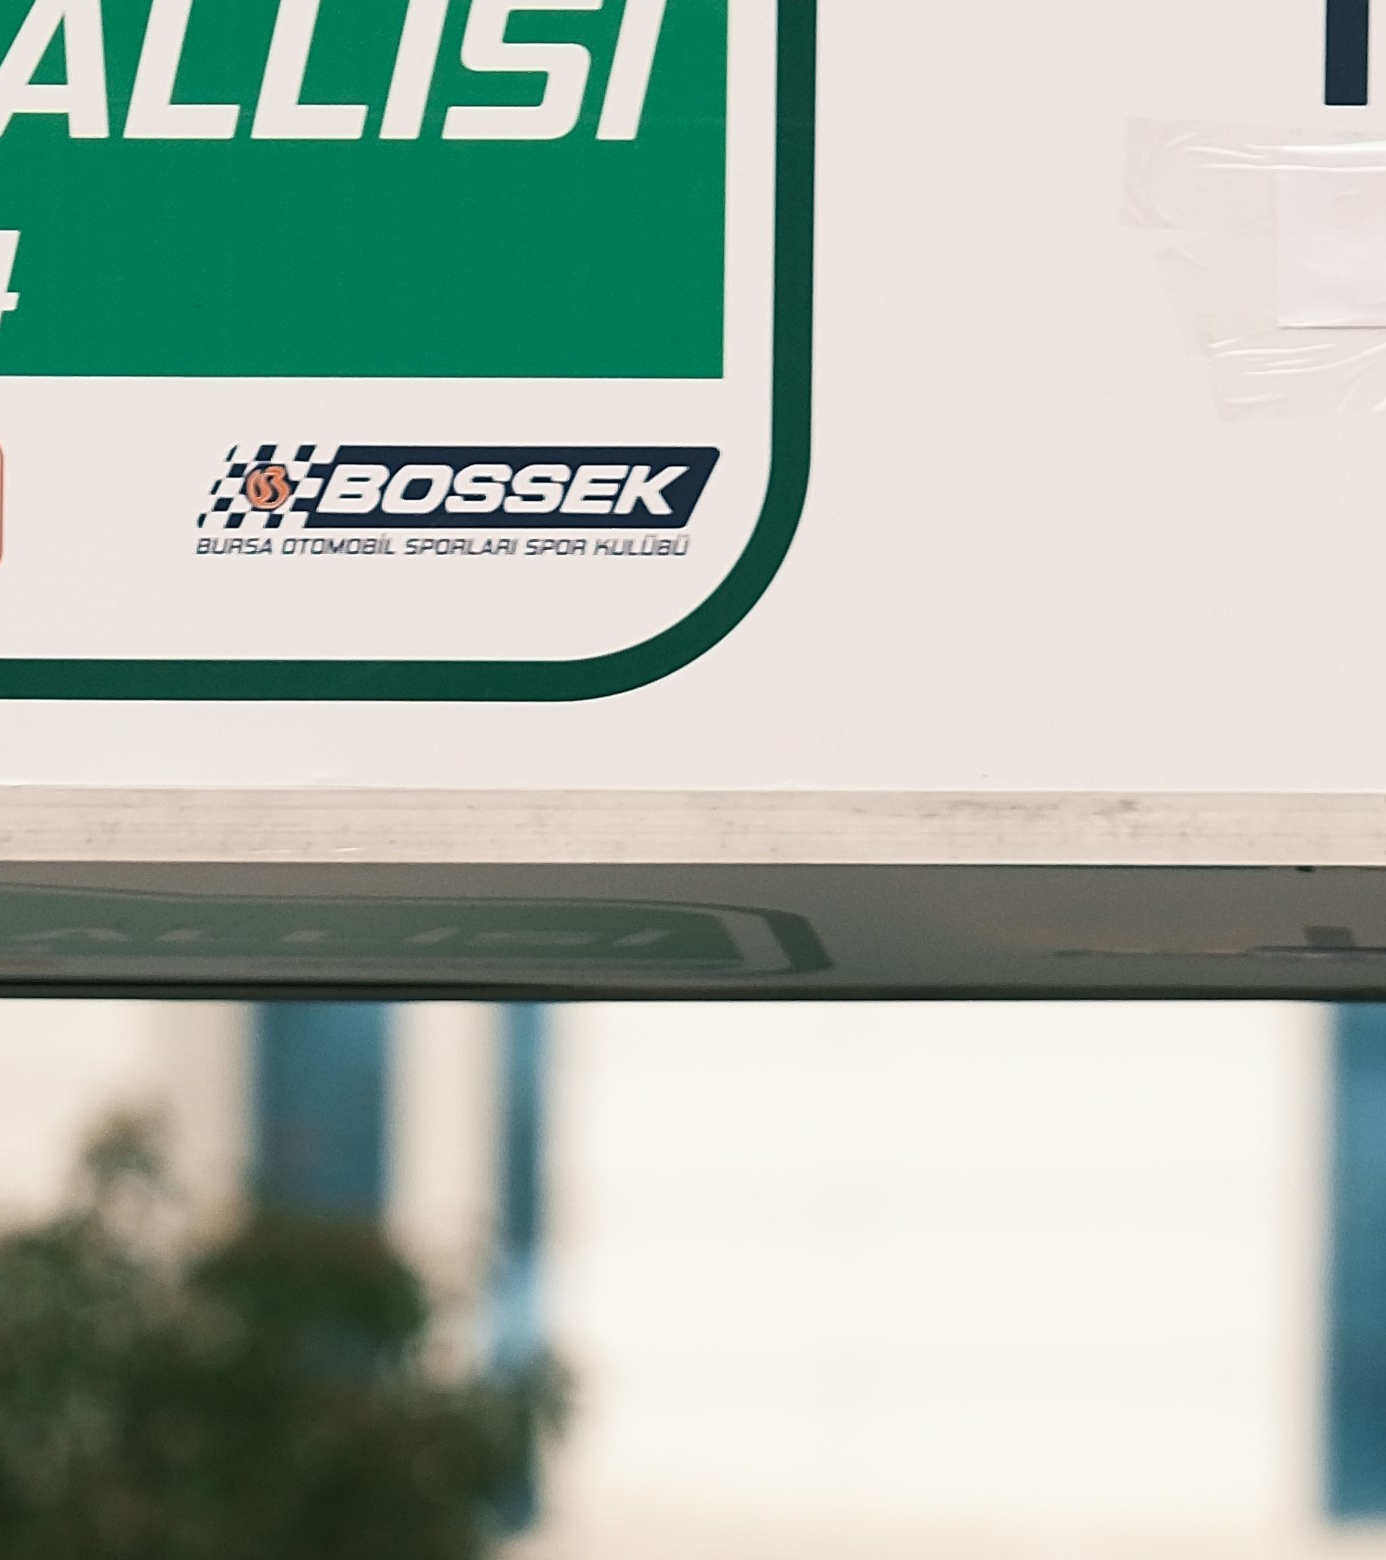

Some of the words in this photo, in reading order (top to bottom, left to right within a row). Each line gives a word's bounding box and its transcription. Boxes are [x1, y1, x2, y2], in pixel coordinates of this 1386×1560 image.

[316, 464, 690, 515] BOSSEK
[197, 538, 272, 555] BURSA
[282, 532, 395, 556] OTOMOBİL
[404, 537, 518, 556] SPORLARI
[524, 537, 585, 556] SPOR
[594, 533, 690, 557] KULÜBÜ
